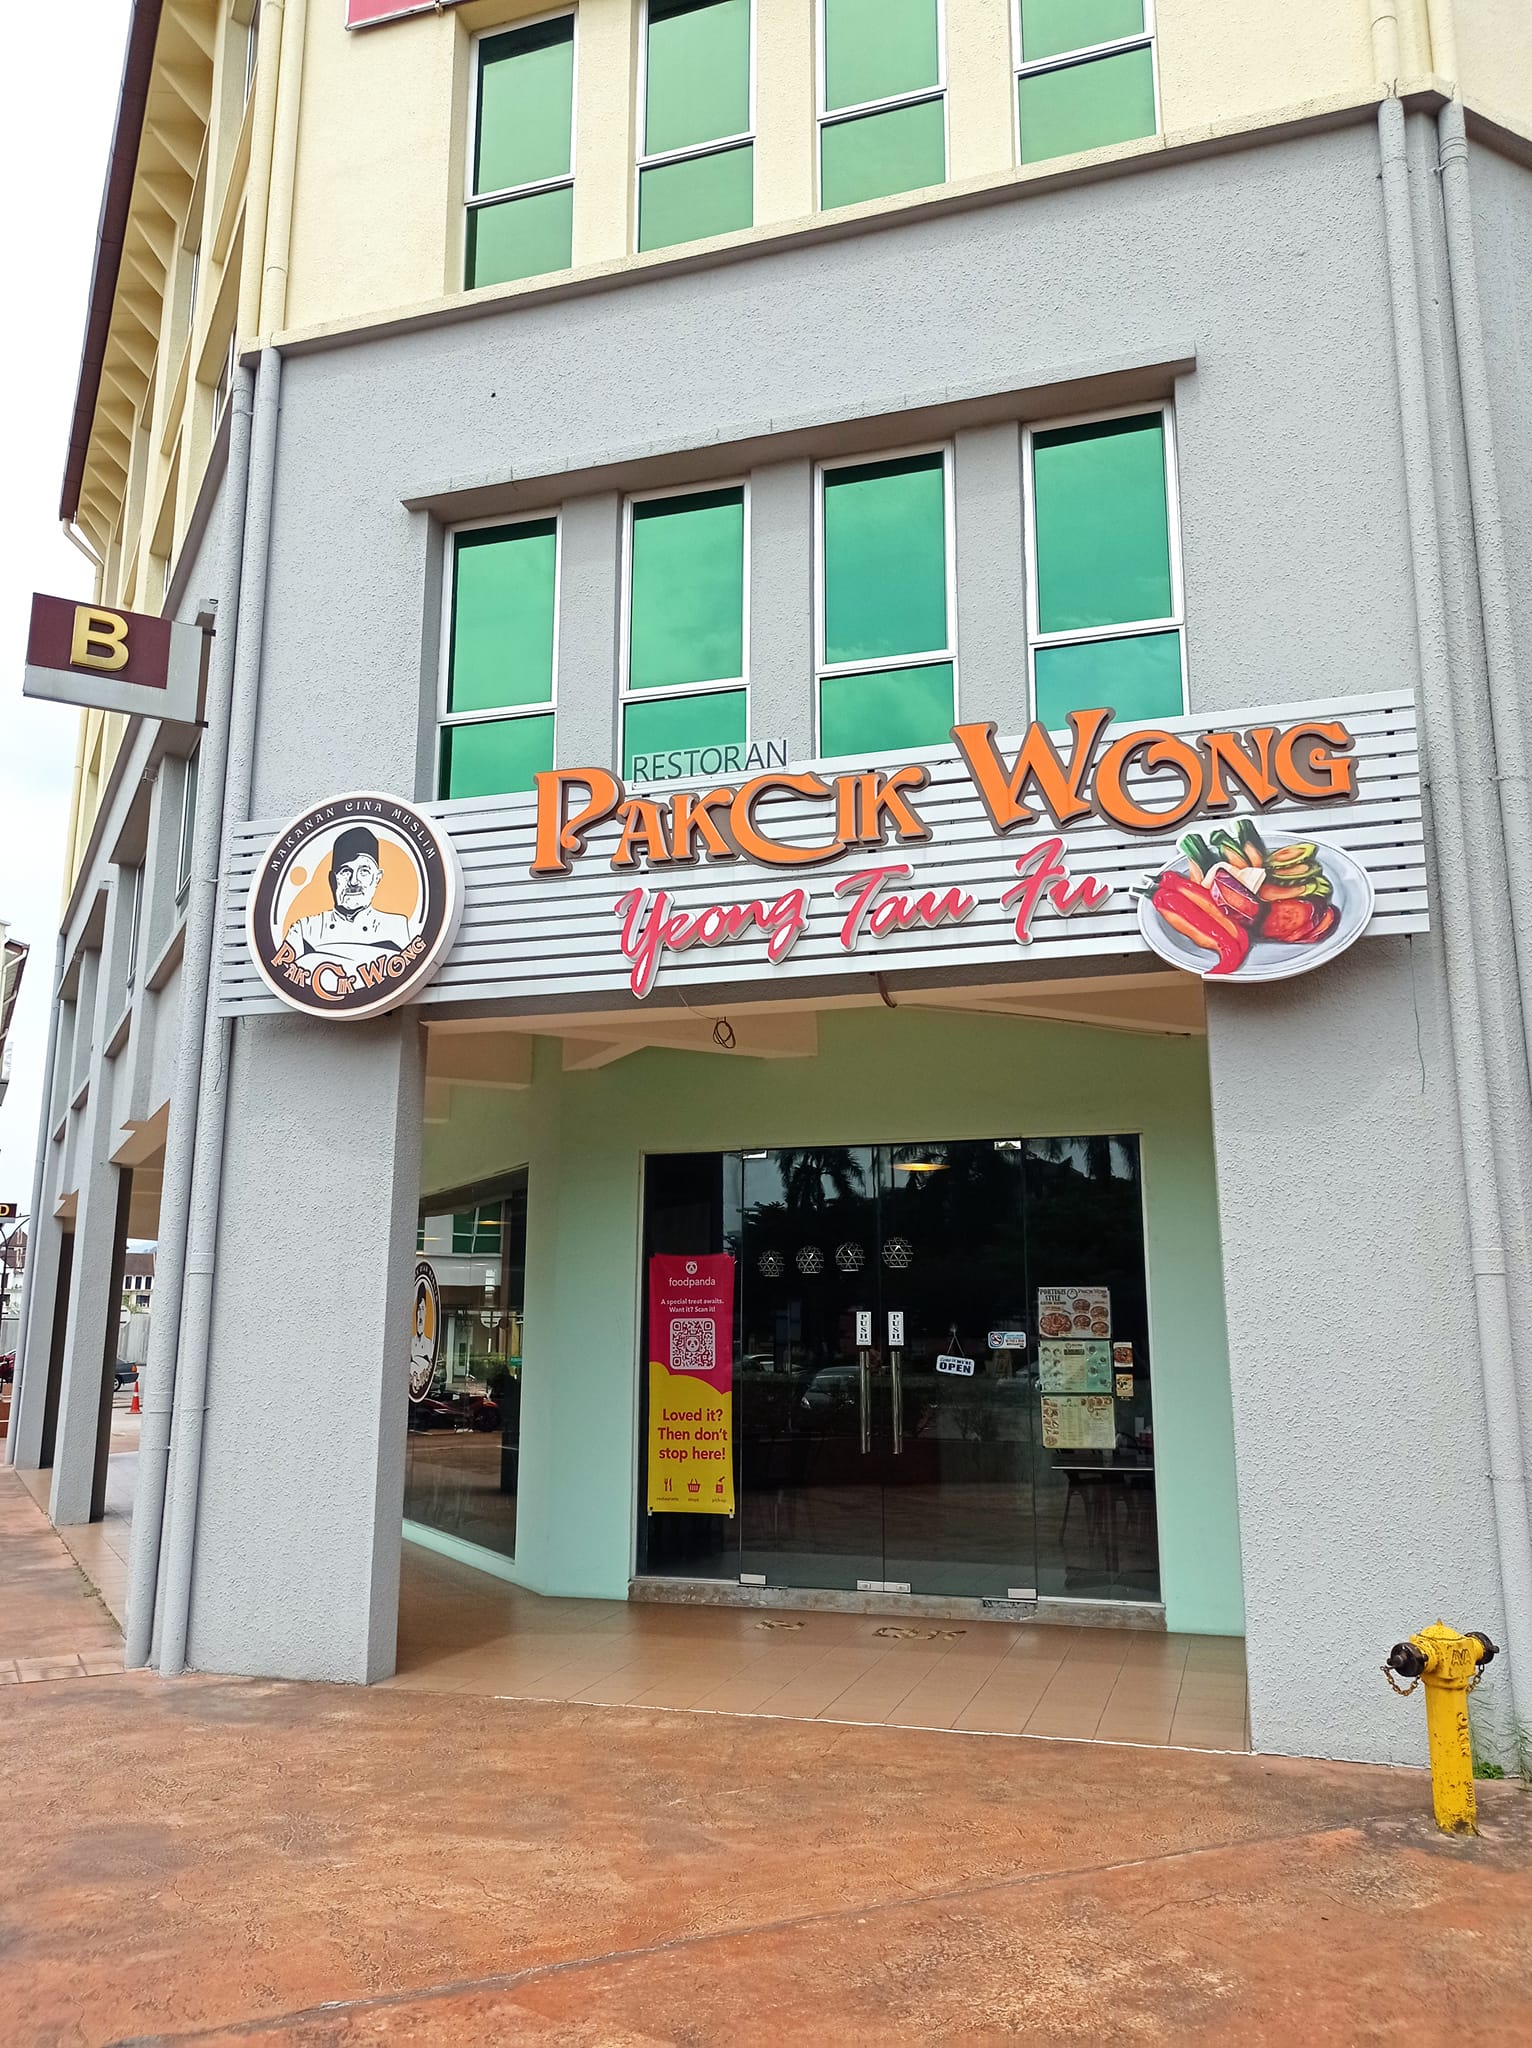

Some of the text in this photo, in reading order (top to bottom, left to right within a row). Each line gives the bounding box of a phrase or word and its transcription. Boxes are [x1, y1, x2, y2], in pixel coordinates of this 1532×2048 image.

[70, 606, 129, 672] B
[633, 739, 788, 783] RESTORAN
[949, 706, 1360, 836] WONG
[271, 801, 436, 872] MAKANAN CINA MUSLIM
[614, 837, 1114, 1000] Yeong Tau Fu
[357, 935, 427, 989] WONG
[669, 1276, 716, 1288] foodpanda
[939, 1362, 972, 1374] OPEN
[657, 1426, 727, 1441] Then don't
[662, 1408, 723, 1421] Loved it?
[659, 1446, 725, 1463] stop here!
